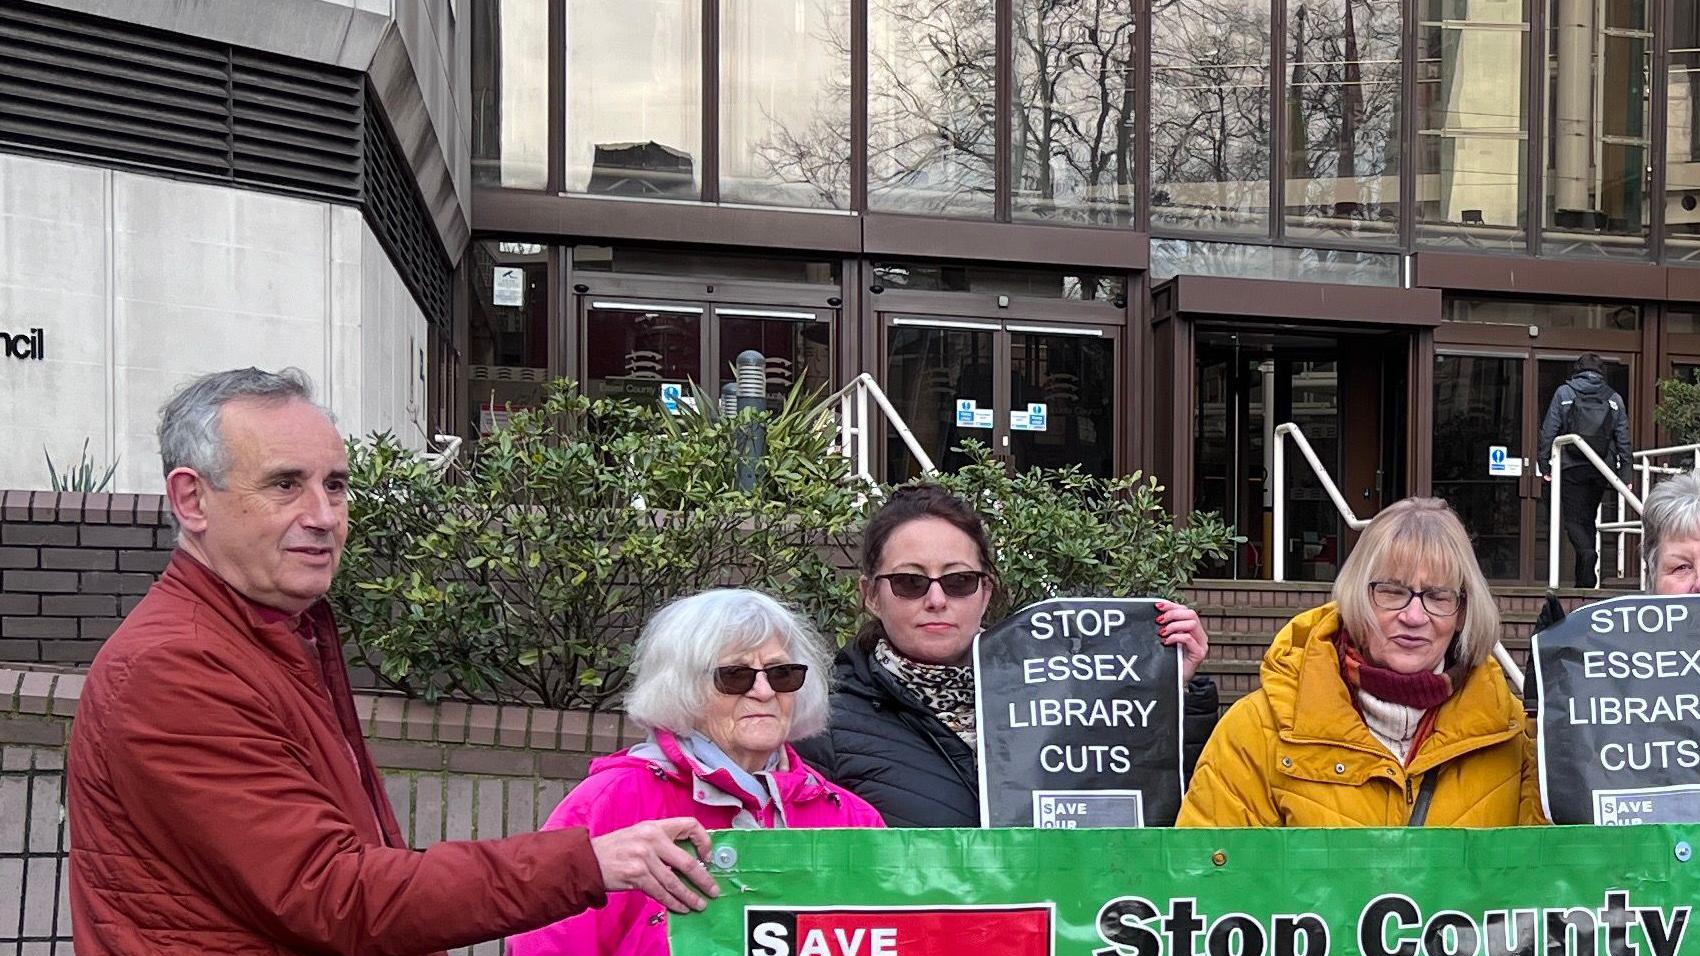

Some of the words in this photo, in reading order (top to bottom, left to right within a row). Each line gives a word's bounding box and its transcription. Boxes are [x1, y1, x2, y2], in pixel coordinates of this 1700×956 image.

[1031, 608, 1126, 640] STOP
[1591, 604, 1688, 633] STOP
[1023, 654, 1141, 684] ESSEX
[1009, 699, 1157, 728] LIBRARY
[1040, 744, 1131, 773] CUTS
[1600, 740, 1700, 771] CUTS
[1043, 803, 1087, 814] SAVE
[1604, 800, 1653, 813] SAVE
